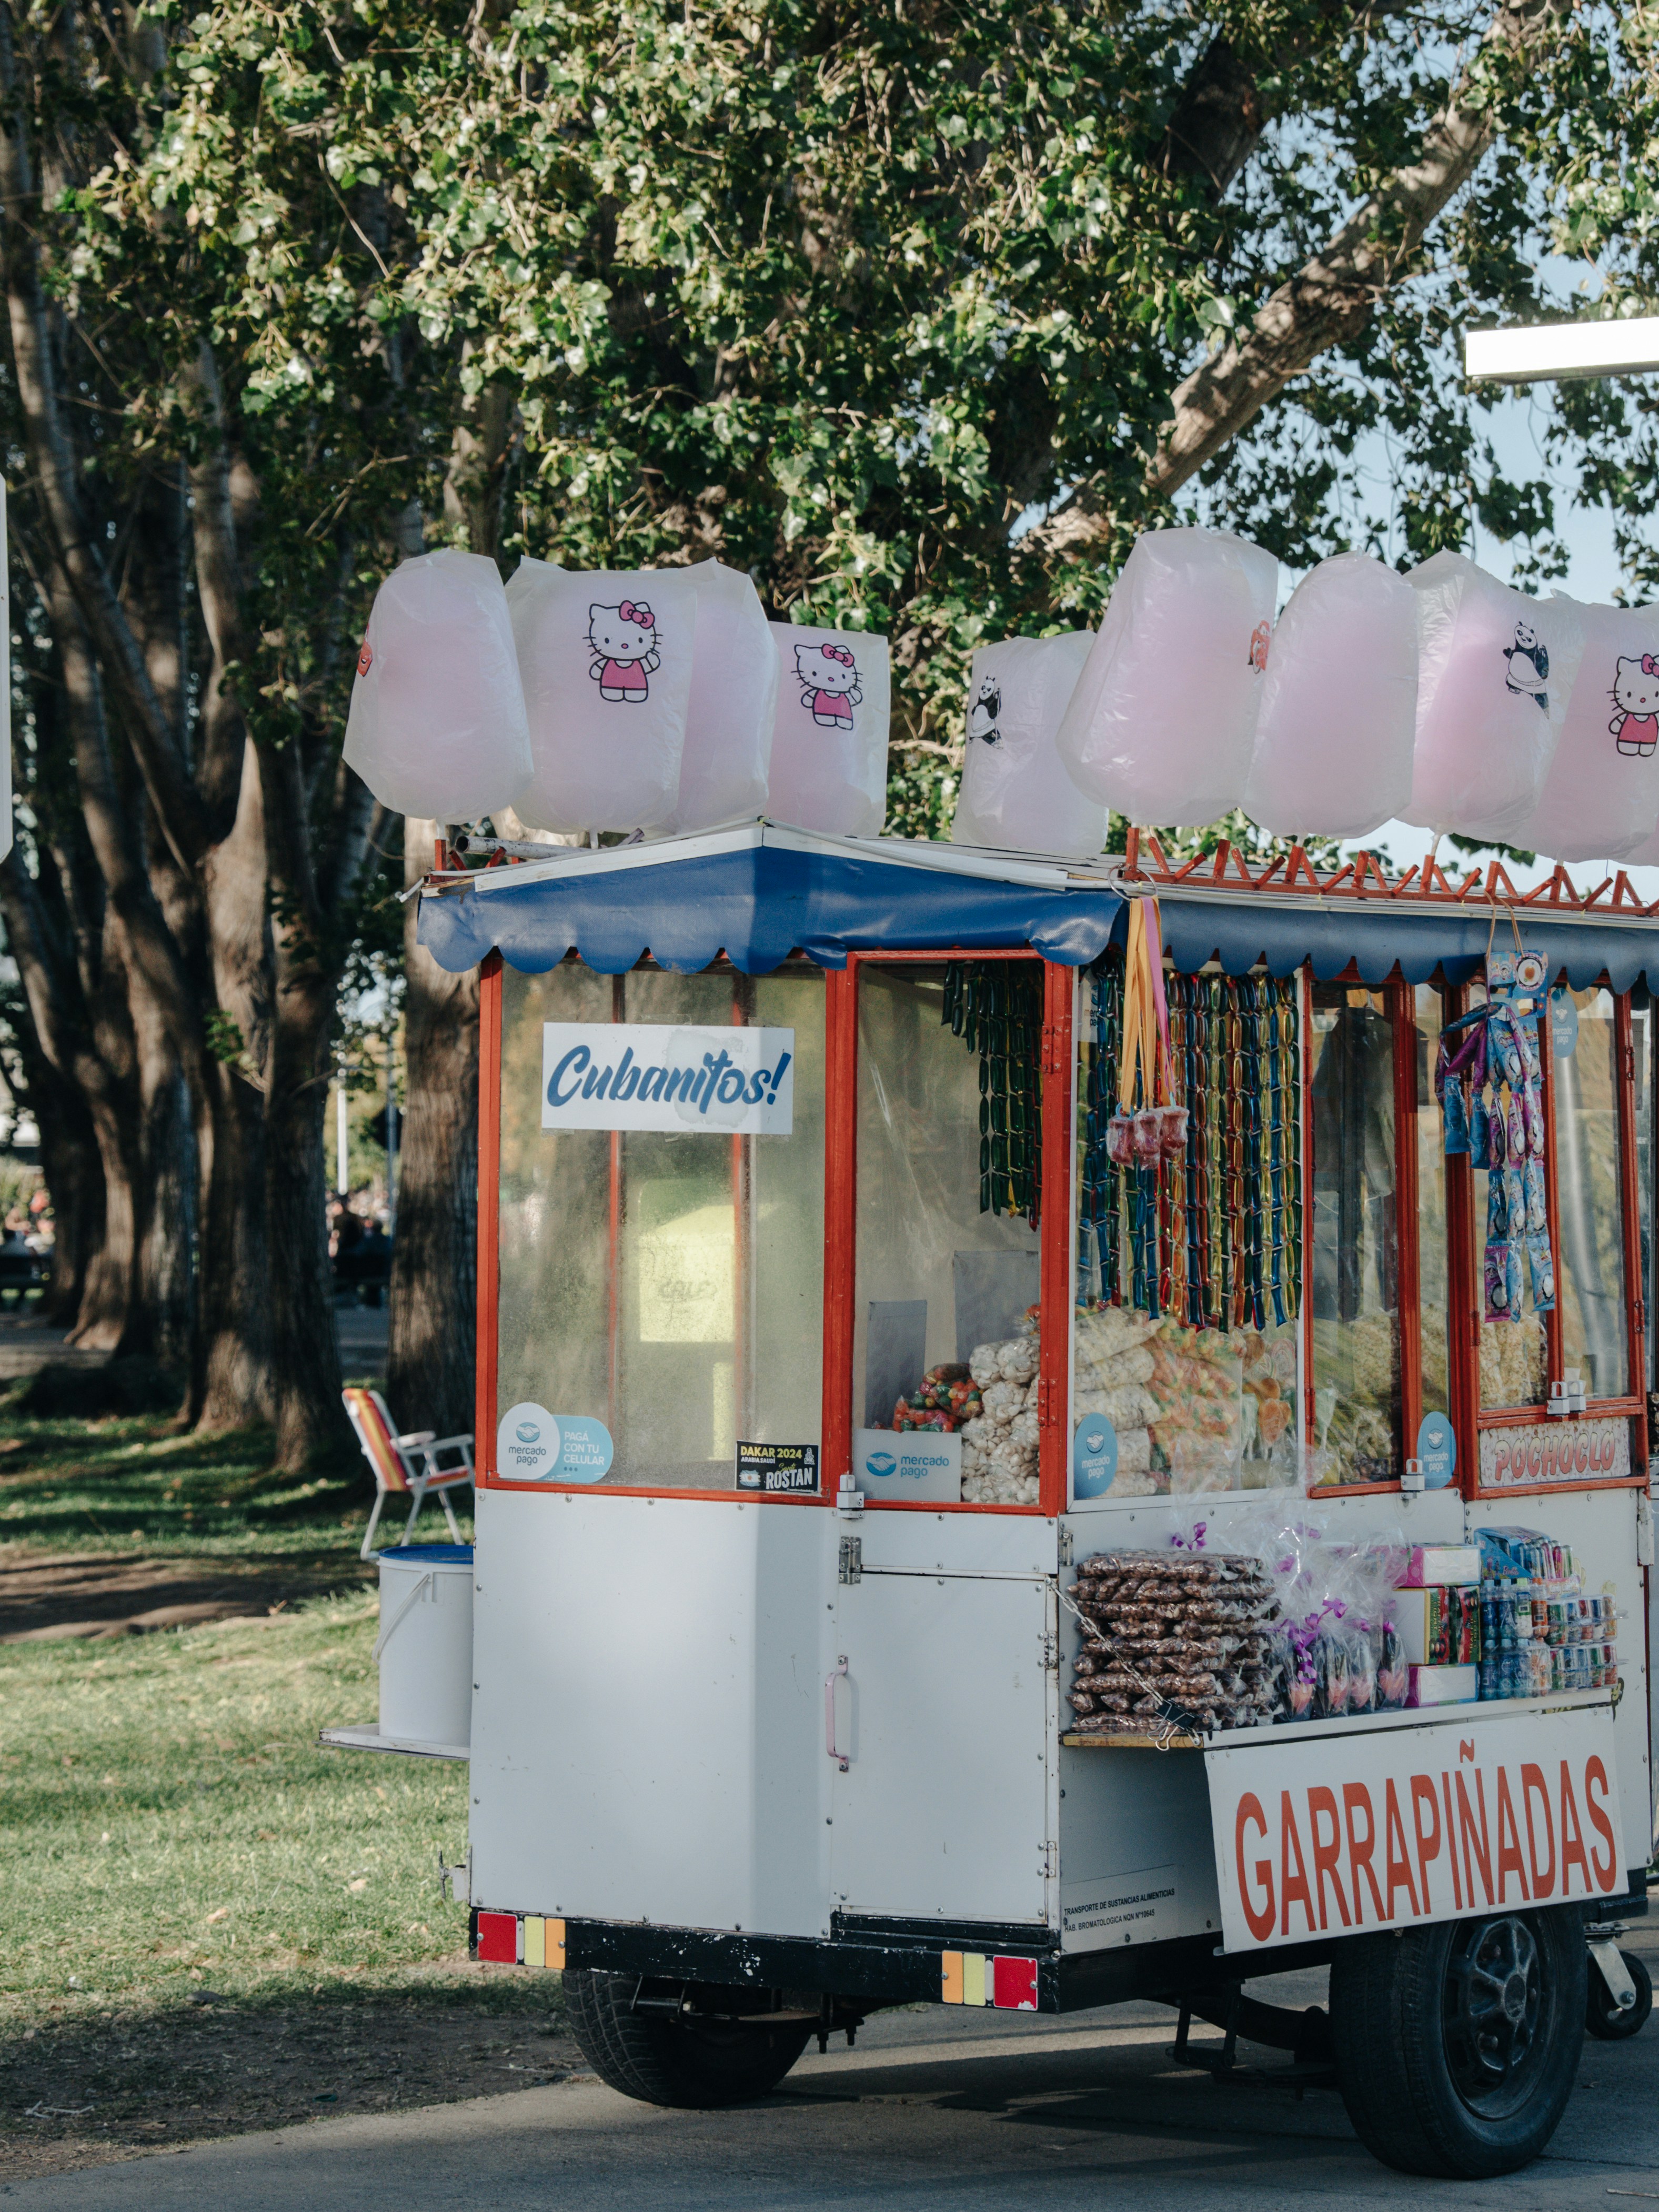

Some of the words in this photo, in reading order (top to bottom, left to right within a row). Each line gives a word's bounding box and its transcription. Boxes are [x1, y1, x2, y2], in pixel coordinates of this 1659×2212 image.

[1553, 1027, 1572, 1035] mercado
[1557, 1035, 1568, 1045] pago
[547, 1045, 791, 1114] Cubanitos!
[564, 1431, 589, 1442] PAGÁ
[509, 1446, 546, 1455] mercado
[564, 1443, 585, 1452] CON
[587, 1444, 599, 1453] TU
[740, 1446, 776, 1457] DAKAR
[777, 1448, 802, 1459] 2024
[516, 1455, 538, 1465] pago
[564, 1454, 605, 1465] CELULAR
[901, 1456, 949, 1466] mercado
[1423, 1452, 1449, 1462] mercado
[1494, 1431, 1615, 1481] POCHOCLO
[1082, 1455, 1110, 1469] mercado
[1429, 1462, 1444, 1473] pago
[766, 1467, 812, 1490] ROSTAN
[900, 1467, 928, 1479] pago
[1088, 1467, 1104, 1480] pago
[1235, 1738, 1617, 1942] GARRAPIÑADAS
[1064, 1903, 1099, 1916] TRANSPORTE
[1108, 1896, 1140, 1908] SUSTANCIAS
[1140, 1888, 1175, 1902] ALIMENTICIAS
[1064, 1924, 1077, 1933] HAB.
[1079, 1916, 1122, 1931] BROMATOLOGICA
[1123, 1913, 1134, 1922] NQN
